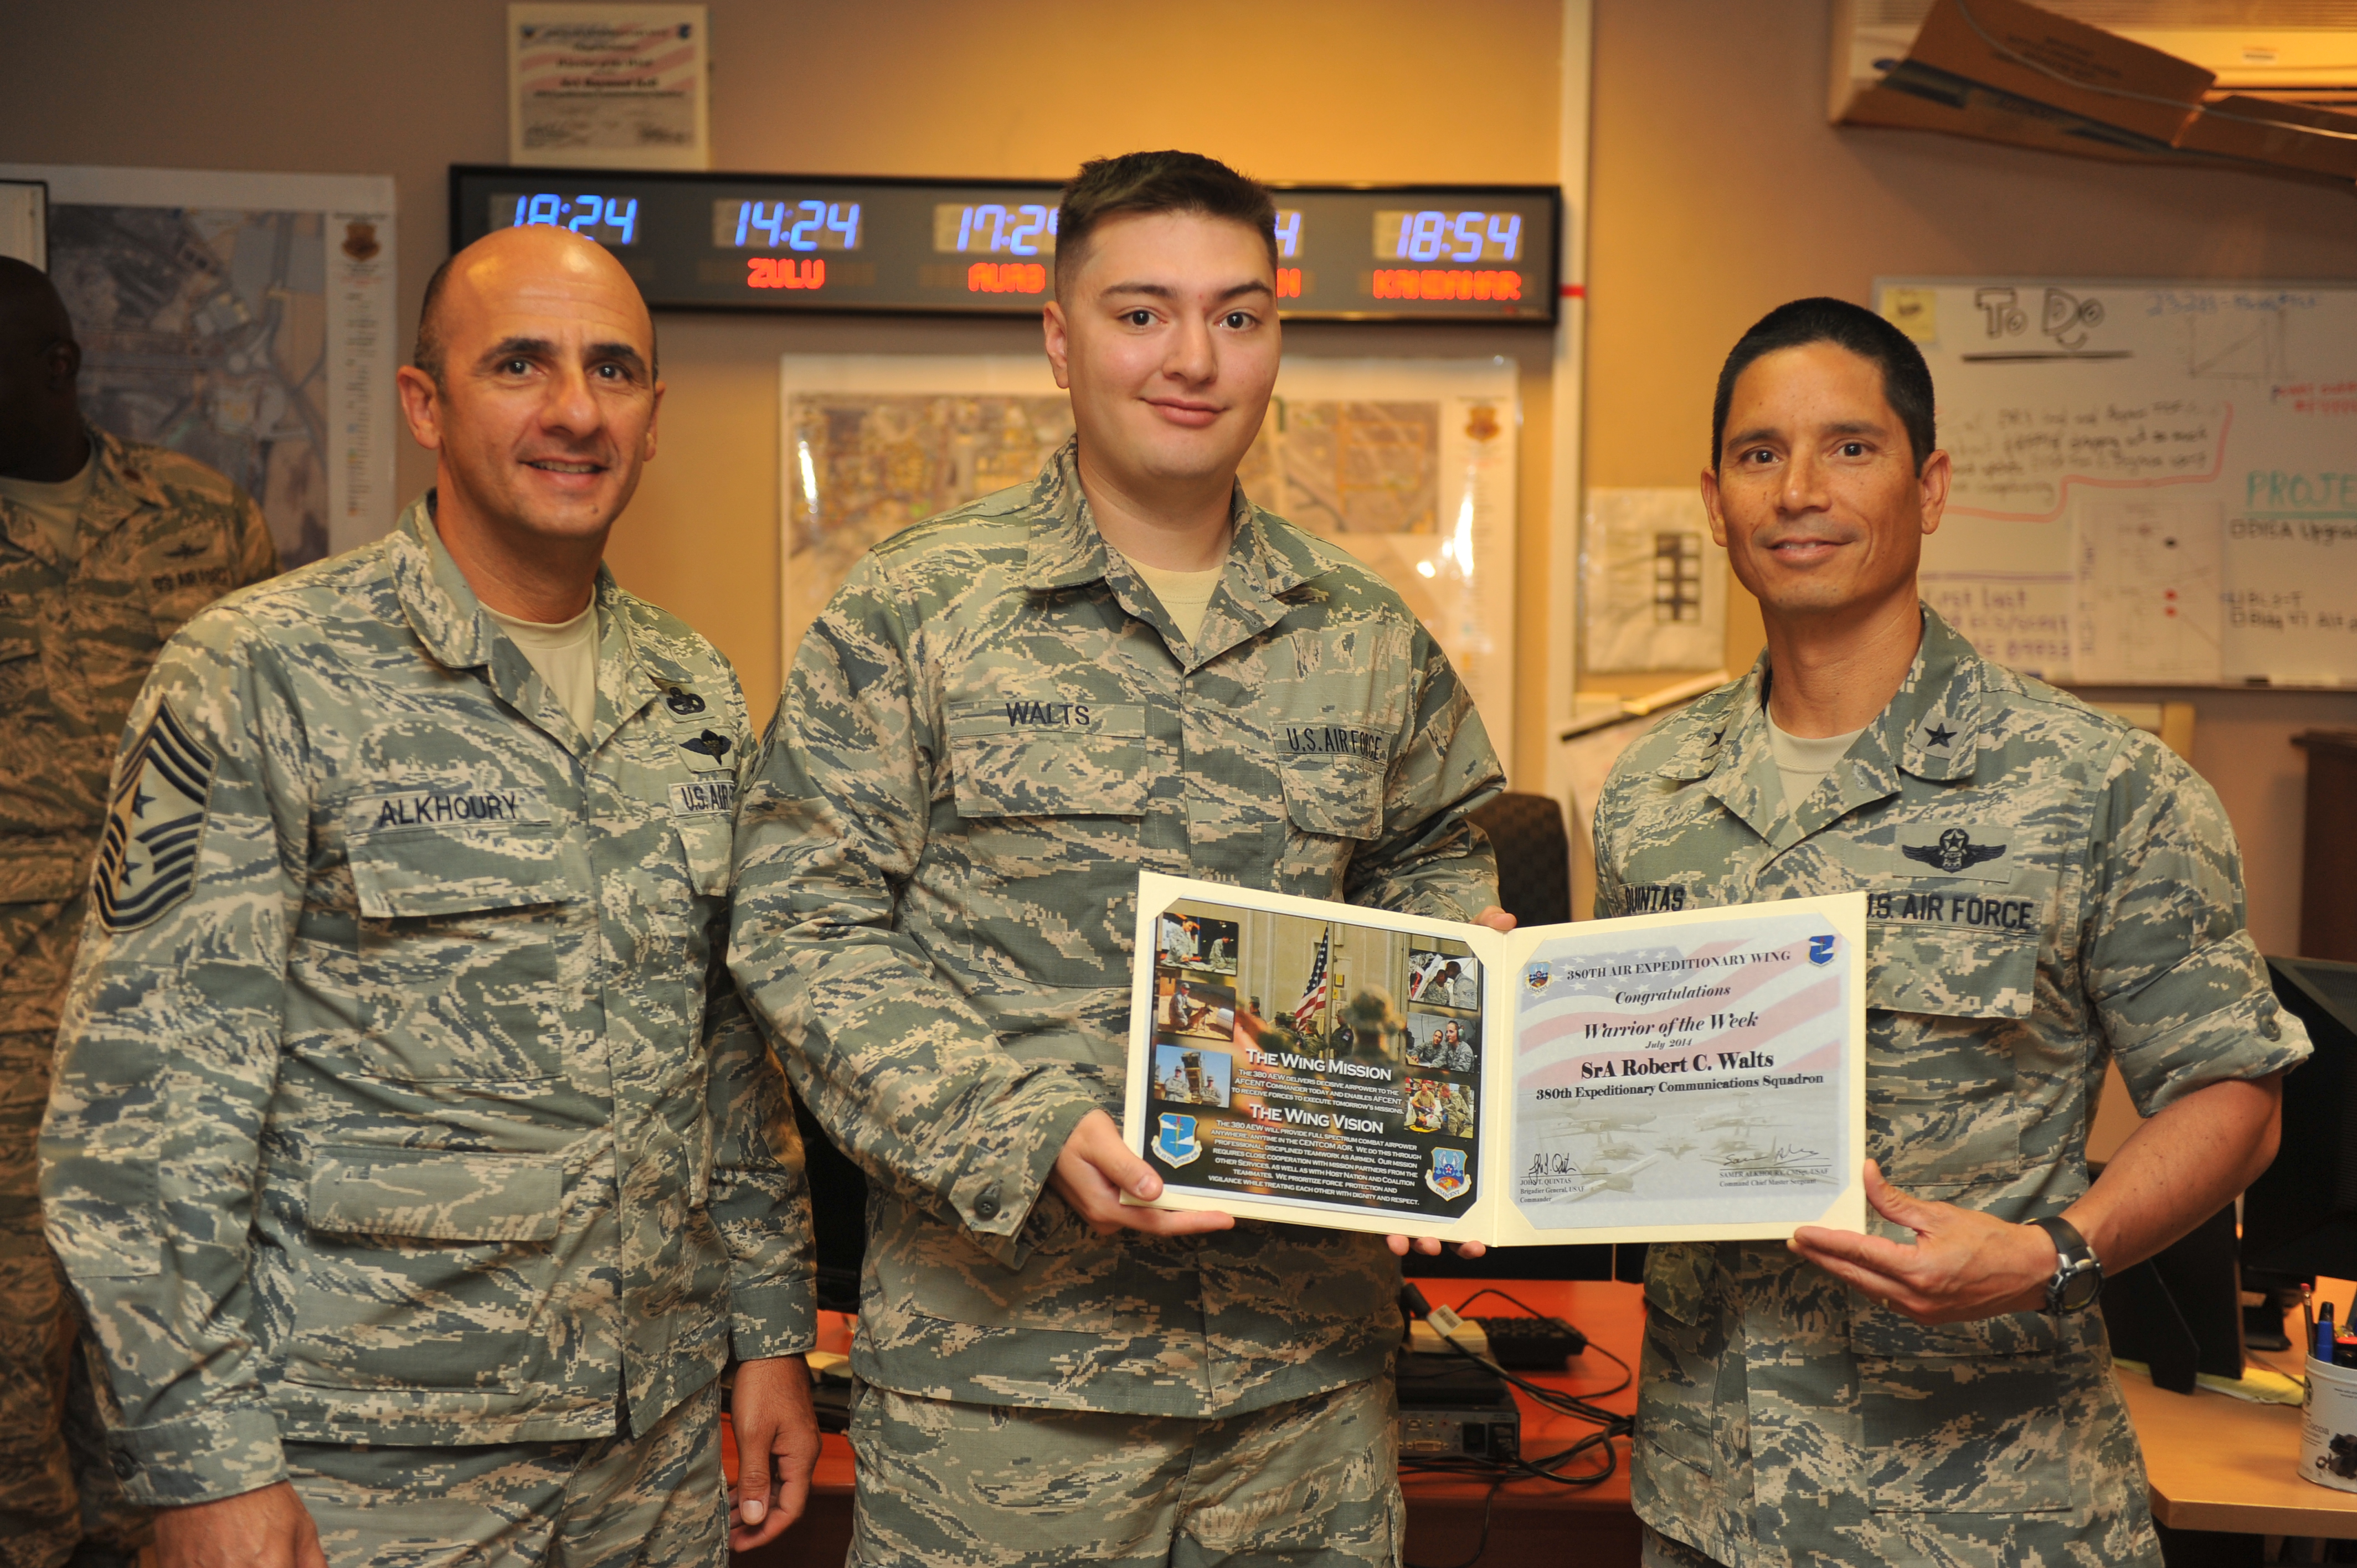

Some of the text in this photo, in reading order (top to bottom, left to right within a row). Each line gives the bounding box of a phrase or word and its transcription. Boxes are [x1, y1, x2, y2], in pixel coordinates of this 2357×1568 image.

[735, 200, 860, 250] 14:24
[1397, 211, 1521, 262] 18:54
[748, 257, 825, 288] ZULU
[1974, 287, 2106, 350] To Do
[1006, 701, 1090, 728] WALTS
[1286, 728, 1382, 760] U.S. AIR FORCE
[379, 794, 516, 827] ALKHOURY
[681, 786, 708, 811] U.S.
[1625, 886, 1685, 912] QUINTAS
[1903, 893, 1943, 921] AIR
[1952, 896, 2034, 929] FORCE
[1567, 951, 1791, 980] 380TH AIR EXPEDITIONARY WING
[1615, 984, 1731, 1005] Congratulations
[1585, 1012, 1759, 1039] Warrior of the Week
[1645, 1038, 1692, 1050] July 2014
[1246, 1048, 1392, 1081] THE WING MISSION
[1581, 1051, 1774, 1079] SrA Robert C. Walts
[1235, 1078, 1265, 1086] AFCENT
[1265, 1081, 1308, 1093] COMMANDER
[1344, 1092, 1372, 1101] ENABLES
[1373, 1095, 1402, 1105] AFCENT
[1268, 1072, 1285, 1081] AEW
[1286, 1076, 1315, 1086] DELIVERS
[1316, 1079, 1344, 1089] DECISIVE
[1345, 1083, 1377, 1094] AIRPOWER
[1536, 1074, 1824, 1100] 380th Expeditionary Communications Squadron
[1241, 1087, 1268, 1097] RECEIVE
[1268, 1091, 1293, 1100] FORCES
[1304, 1096, 1331, 1105] EXECUTE
[1332, 1099, 1374, 1111] TOMORROW'S
[1375, 1105, 1404, 1115] MISSIONS.
[1249, 1103, 1384, 1134] THE WING VISION
[1214, 1139, 1264, 1151] PROFESSIONAL,
[1264, 1145, 1303, 1154] DISCIPLINED
[1304, 1149, 1340, 1159] TEAMWORK
[1350, 1154, 1376, 1163] AIRMEN.
[1250, 1134, 1277, 1143] ANYTIME
[1299, 1139, 1336, 1149] CENTCOM
[1392, 1152, 1422, 1160] THROUGH
[1280, 1128, 1308, 1137] PROVIDE
[1324, 1133, 1357, 1143] SPECTRUM
[1358, 1138, 1384, 1147] COMBAT
[1385, 1142, 1417, 1151] AIRPOWER
[1213, 1148, 1245, 1158] REQUIRES
[1267, 1153, 1311, 1164] COOPERATION
[1329, 1161, 1354, 1170] MISSION
[1355, 1164, 1387, 1174] PARTNERS
[1238, 1159, 1270, 1169] SERVICES,
[1344, 1172, 1367, 1182] NATION
[1382, 1177, 1415, 1187] COALITION
[1208, 1175, 1242, 1184] VIGILANCE
[1264, 1182, 1295, 1190] TREATING
[1391, 1197, 1419, 1205] RESPECT.
[1233, 1169, 1273, 1179] TEAMMATES.
[1288, 1175, 1321, 1185] PRIORITIZE
[1345, 1182, 1383, 1192] PROTECTION
